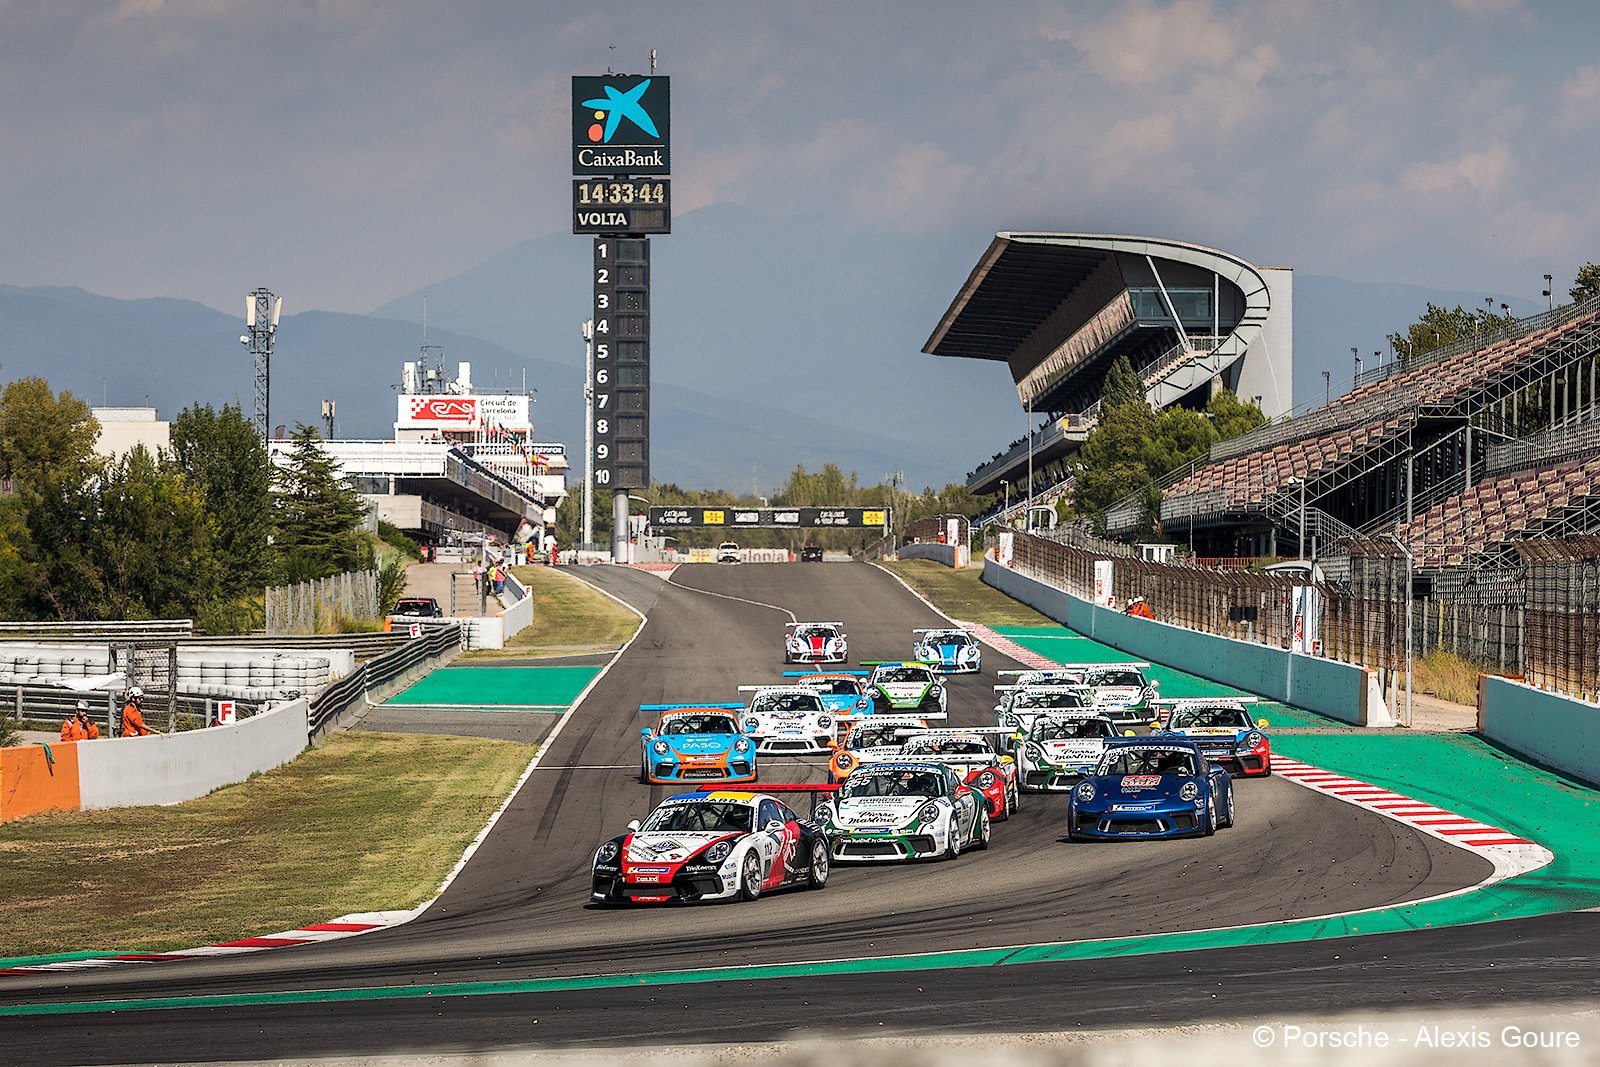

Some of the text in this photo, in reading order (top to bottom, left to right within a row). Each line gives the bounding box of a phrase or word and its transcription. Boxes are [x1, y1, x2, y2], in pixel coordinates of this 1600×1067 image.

[578, 149, 664, 167] CaixaBank
[579, 183, 664, 203] 14:33:44
[577, 212, 628, 226] VOLTA
[598, 244, 608, 258] 1
[597, 269, 609, 283] 2
[597, 294, 609, 309] 3
[597, 320, 609, 334] 4
[597, 345, 609, 359] 5
[597, 370, 609, 384] 6
[597, 394, 609, 409] 7
[597, 419, 609, 434] 8
[597, 444, 609, 459] 9
[595, 469, 610, 484] 10
[1107, 597, 1114, 606] F
[411, 625, 418, 636] F
[1312, 641, 1321, 654] F
[221, 704, 232, 722] F
